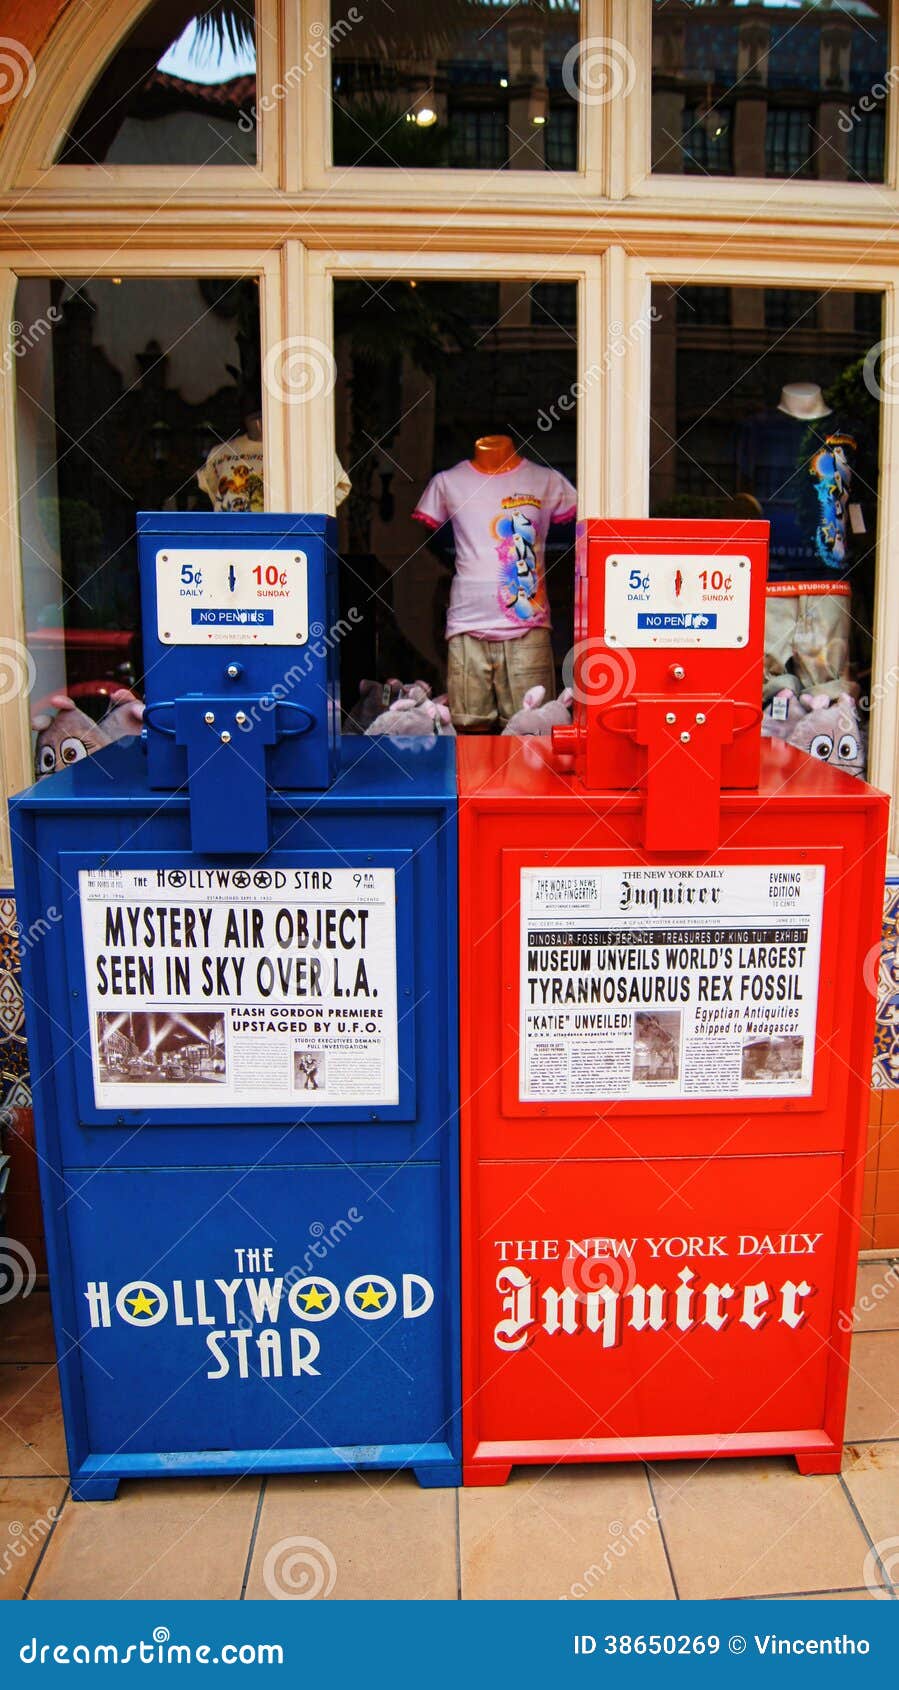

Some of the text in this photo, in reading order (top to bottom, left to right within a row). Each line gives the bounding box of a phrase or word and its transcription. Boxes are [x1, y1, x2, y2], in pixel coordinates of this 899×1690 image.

[180, 564, 288, 588] 5¢ 10¢
[629, 570, 733, 592] 5¢ 10¢
[200, 613, 216, 622] NO
[646, 617, 662, 626] NO
[134, 877, 148, 887] THE
[157, 870, 287, 889] HOLLYWOOD
[294, 871, 333, 889] STAR
[353, 873, 362, 888] 9
[622, 871, 641, 879] THE
[643, 871, 666, 879] NEW
[696, 870, 724, 878] DAILY
[769, 872, 801, 883] EVENING
[538, 880, 549, 892] THE
[580, 880, 596, 888] NEWS
[564, 888, 598, 900] FINGERTIPS
[769, 886, 800, 897] EDITION
[619, 881, 722, 911] Inquirer
[105, 906, 369, 950] MYSTERY AIR OBJECT
[529, 933, 574, 945] DINOSAUR
[577, 933, 612, 945] FOSSILS
[616, 932, 654, 945] REPLACE
[714, 932, 725, 943] OF
[728, 931, 749, 943] KING
[775, 930, 808, 943] EXHIBIT
[528, 946, 806, 972] MUSEUM UNVEILS WORLD'S LARGEST
[96, 954, 378, 998] SEEN IN SKY OVER L.A.
[528, 974, 803, 1004] TYRANNOSAURUS REX FOSSIL
[231, 1008, 383, 1018] FLASH GORDON PREMIERE
[695, 1006, 799, 1022] Egyptian Antiquities
[233, 1022, 382, 1033] UPSTAGED BY U.F.O.
[528, 1014, 632, 1030] "KATIE" UNVEILED!
[694, 1022, 799, 1036] shipped to Madagascar
[494, 1233, 824, 1261] THE NEW YORK DAILY
[235, 1248, 275, 1273] THE
[84, 1273, 435, 1328] HOLLYWOOD
[494, 1265, 815, 1352] Inquirer
[206, 1328, 322, 1380] STAR
